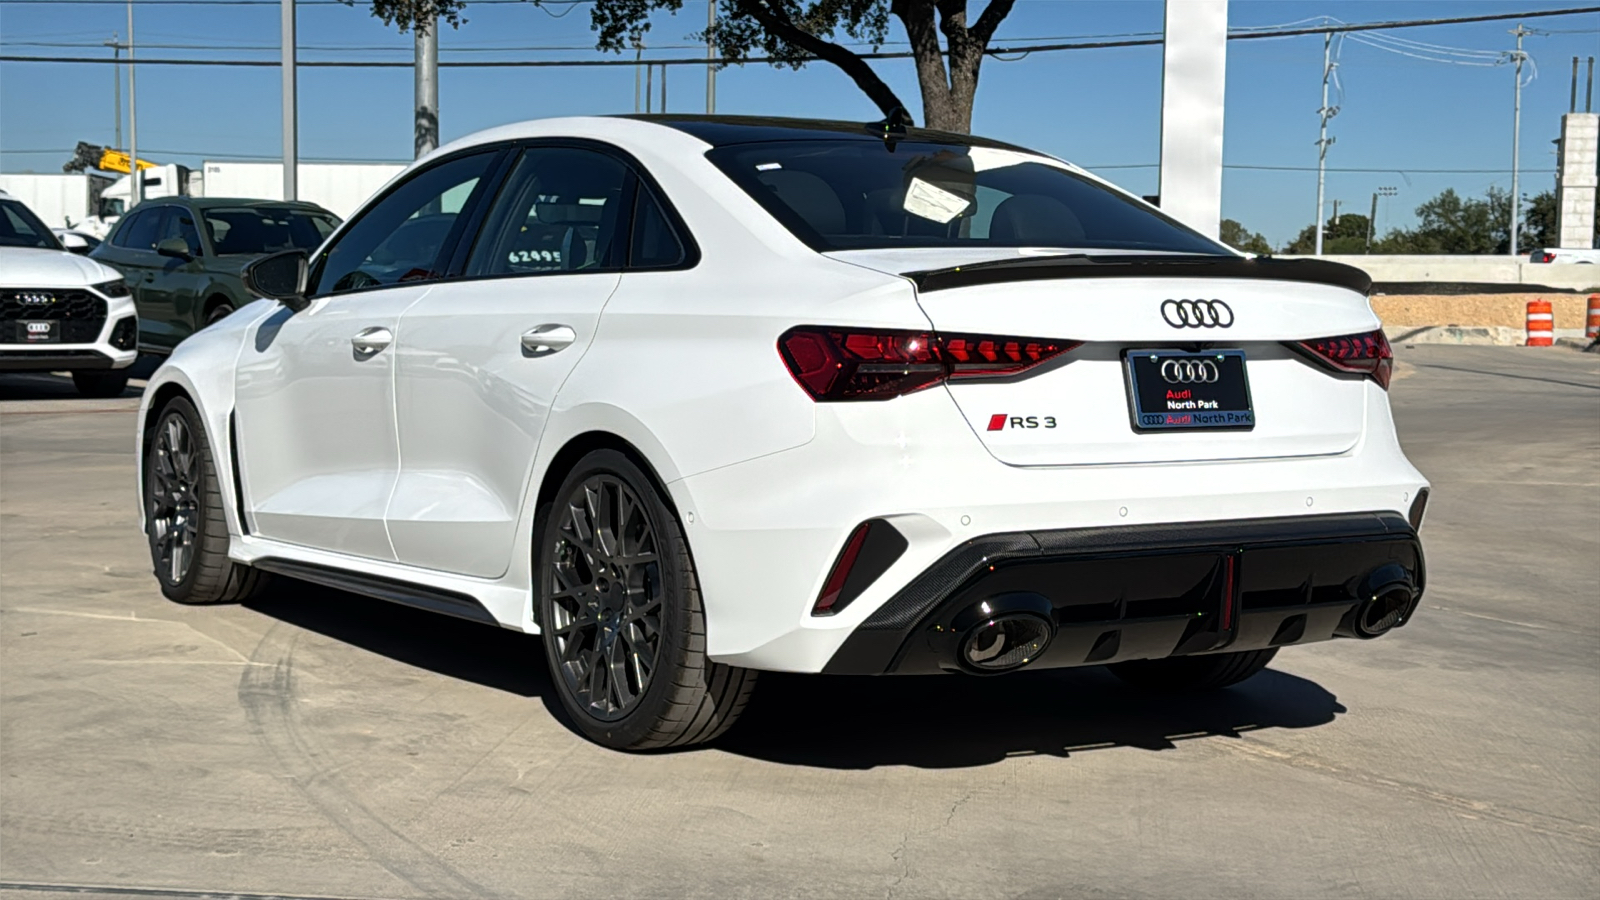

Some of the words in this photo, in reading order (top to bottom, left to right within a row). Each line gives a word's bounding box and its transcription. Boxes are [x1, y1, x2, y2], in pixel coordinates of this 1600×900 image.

[1166, 389, 1191, 399] Audi
[1167, 400, 1196, 409] North
[1197, 400, 1218, 409] Park
[1010, 416, 1040, 429] RS
[1044, 416, 1057, 429] 3
[1166, 414, 1191, 424] Audi
[1193, 414, 1226, 423] North
[1227, 412, 1252, 423] Park
